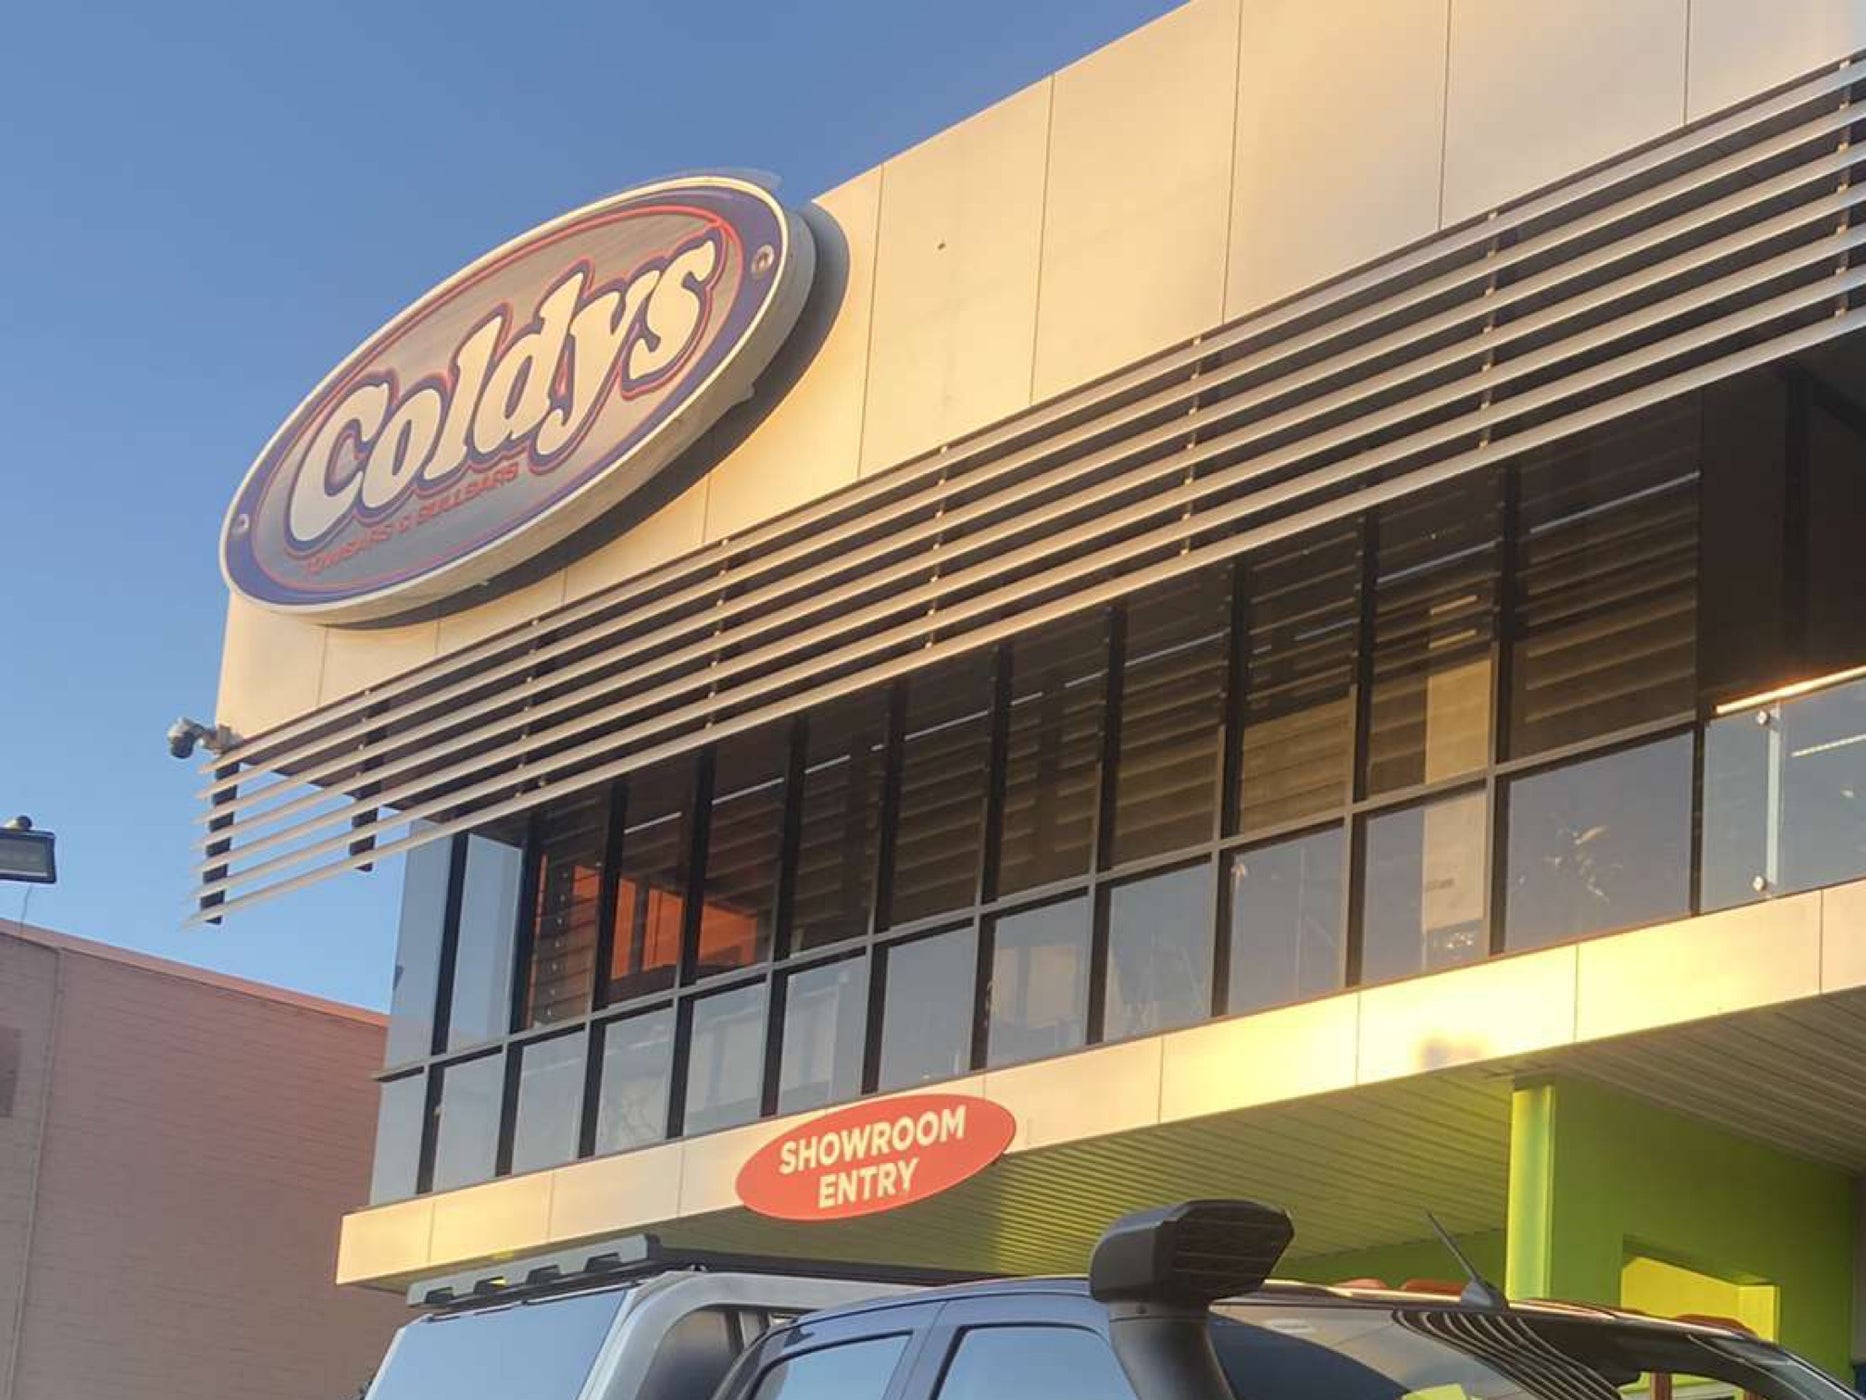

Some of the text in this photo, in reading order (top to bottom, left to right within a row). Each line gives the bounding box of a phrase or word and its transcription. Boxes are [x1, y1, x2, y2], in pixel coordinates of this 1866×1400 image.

[286, 236, 719, 545] Coldys
[778, 1105, 966, 1175] SHOWROOM
[818, 1157, 919, 1209] ENTRY
